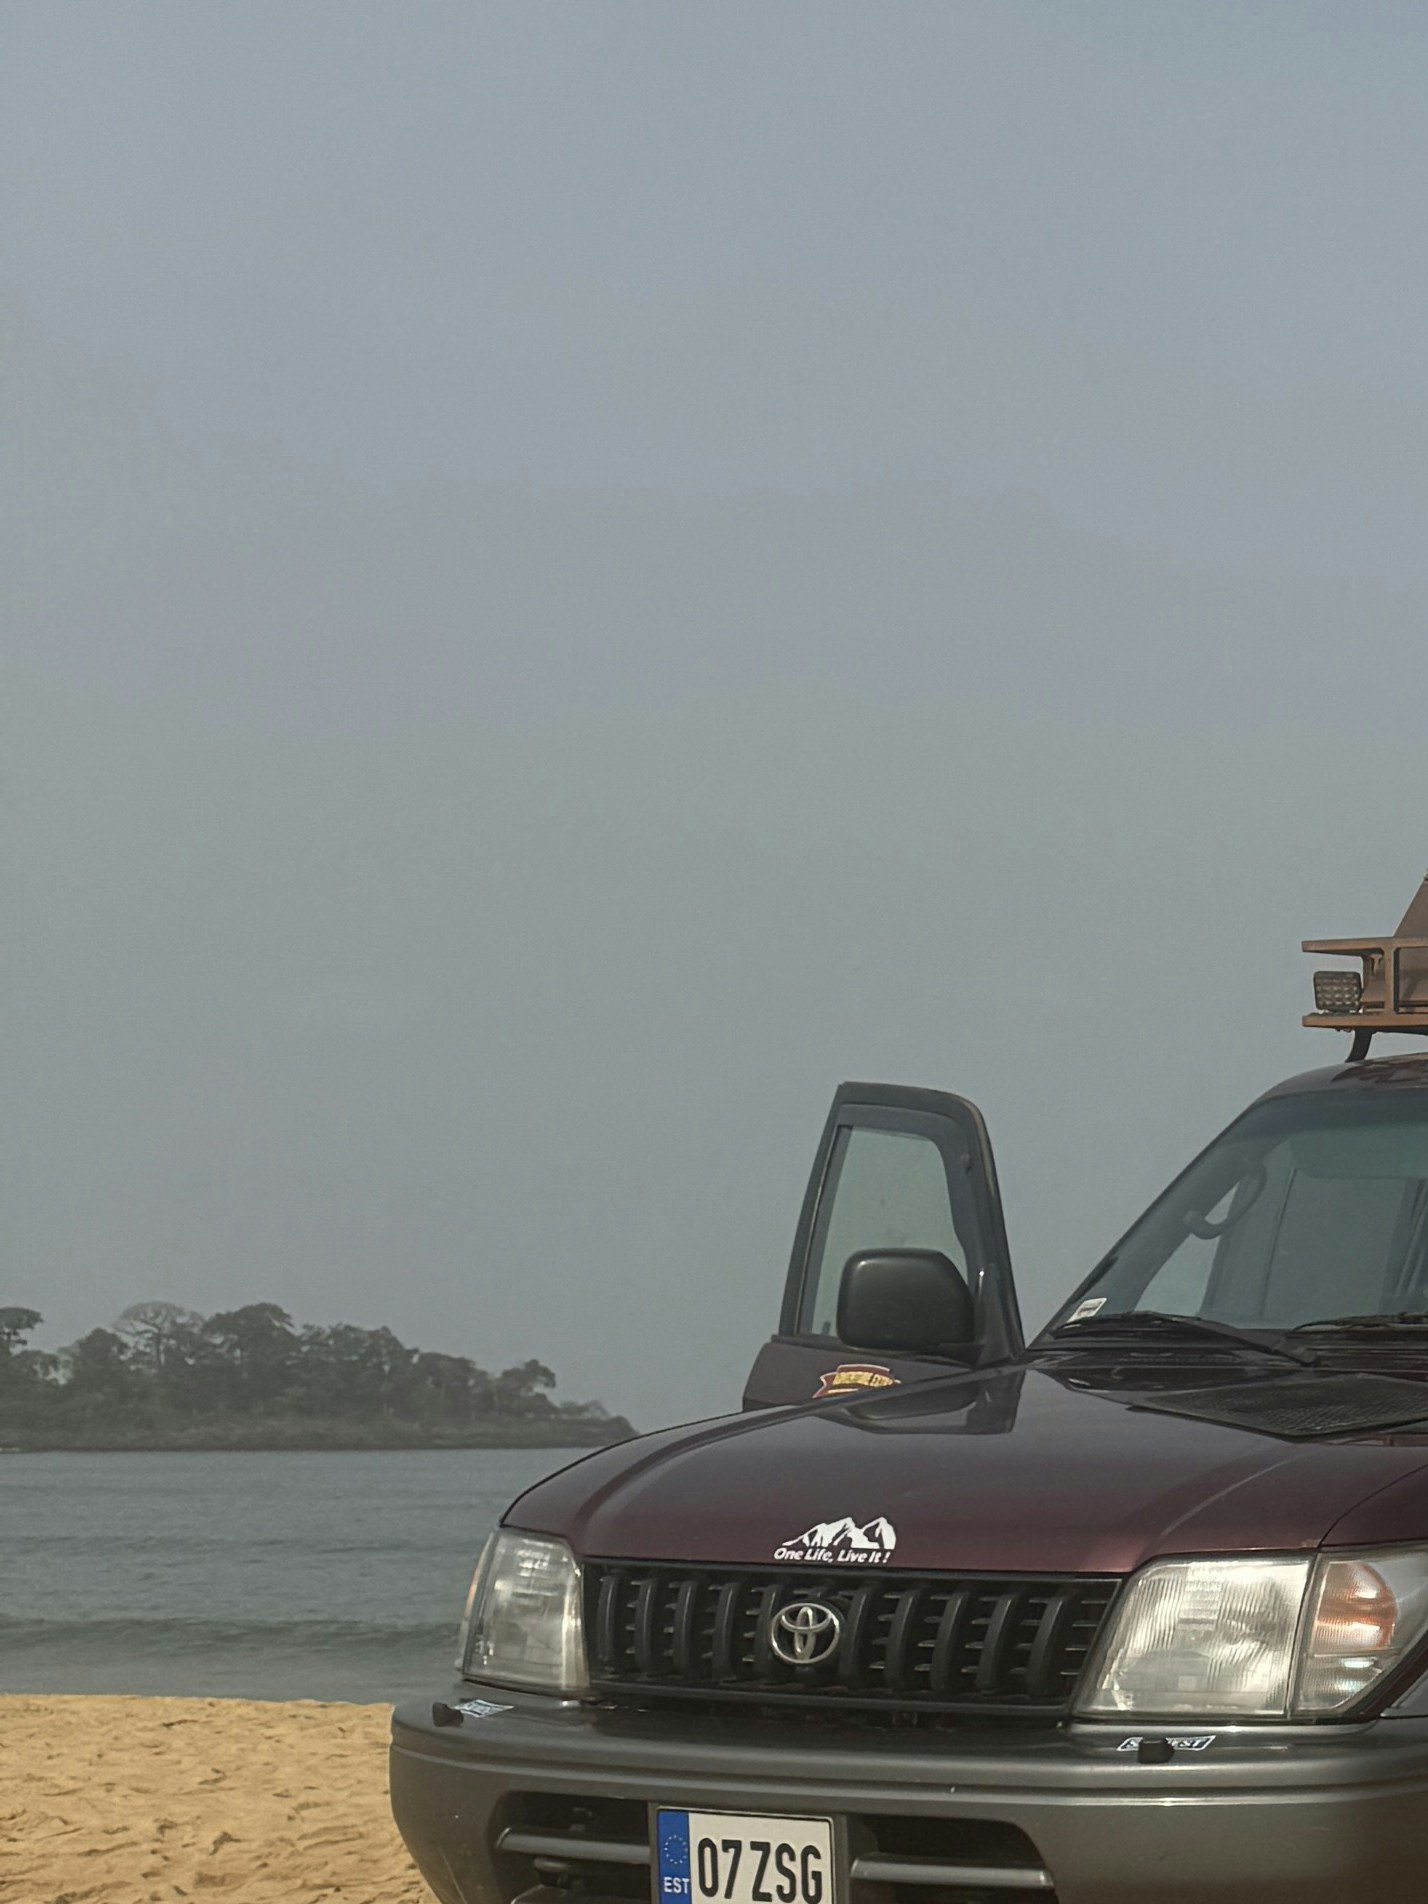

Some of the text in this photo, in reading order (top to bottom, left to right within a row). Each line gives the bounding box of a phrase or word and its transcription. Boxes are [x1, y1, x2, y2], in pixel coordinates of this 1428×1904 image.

[773, 1547, 804, 1561] One
[804, 1548, 834, 1563] Life,
[837, 1549, 868, 1563] Live
[697, 1837, 743, 1900] 07
[663, 1876, 690, 1894] EST
